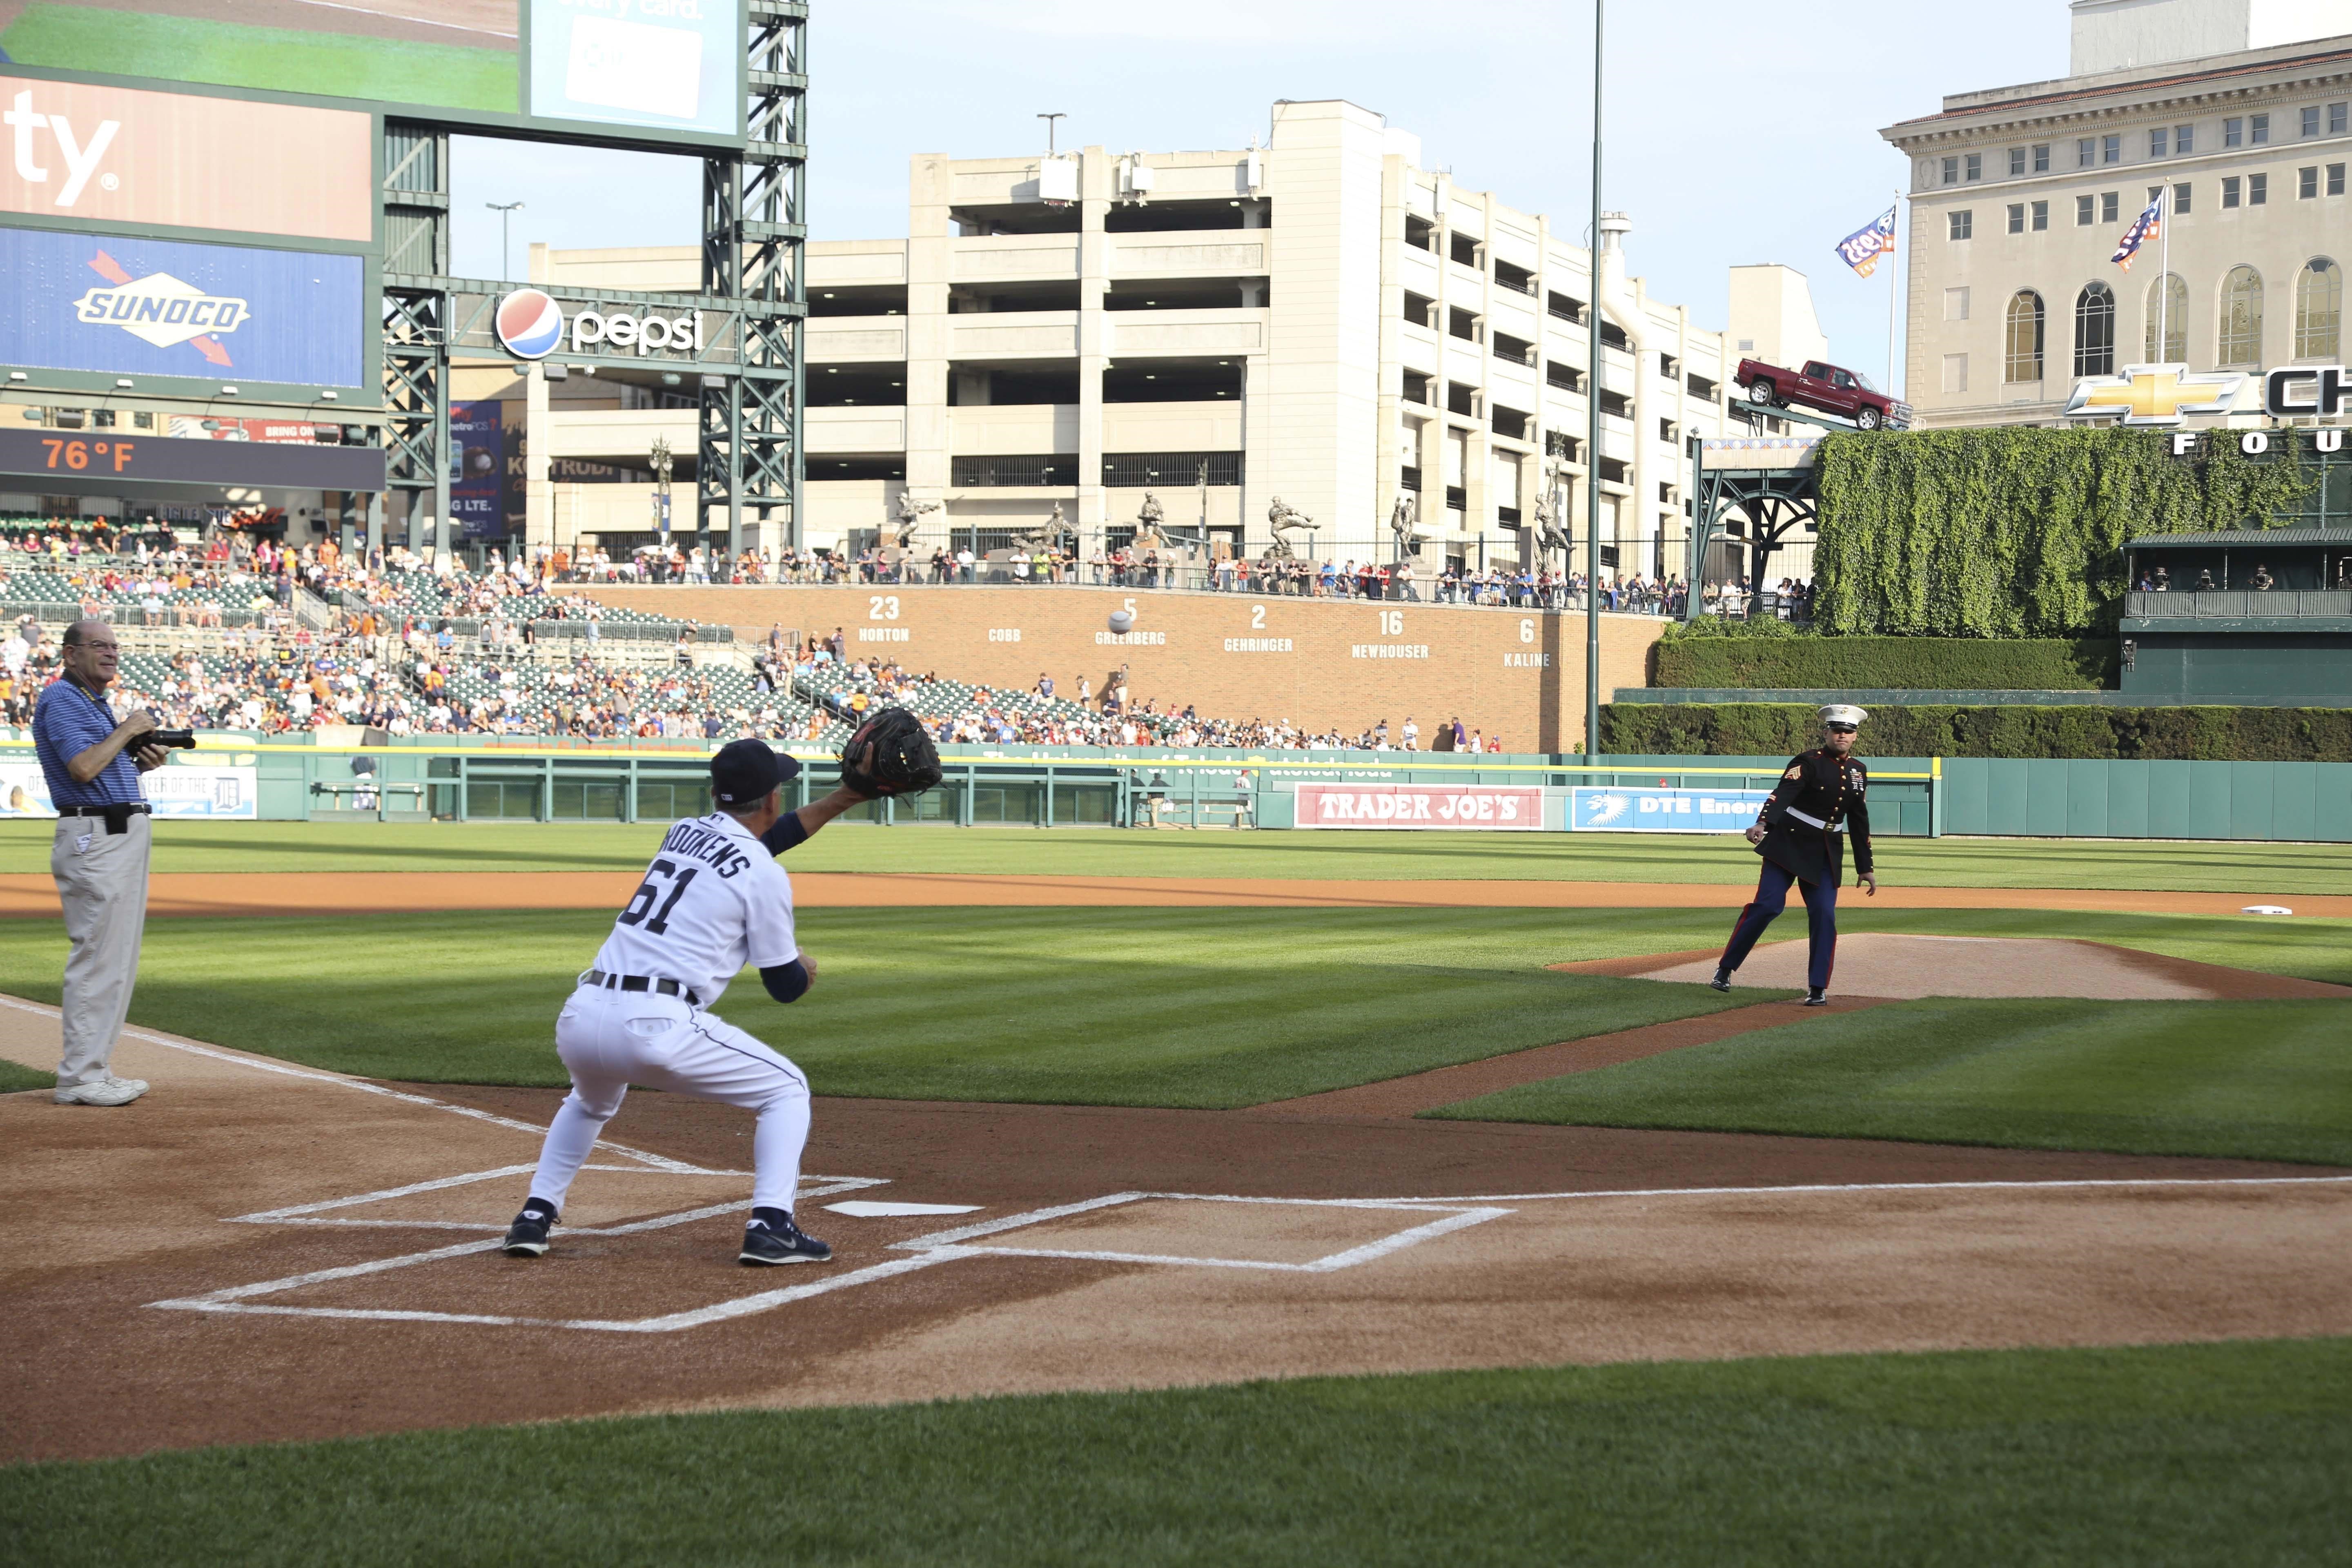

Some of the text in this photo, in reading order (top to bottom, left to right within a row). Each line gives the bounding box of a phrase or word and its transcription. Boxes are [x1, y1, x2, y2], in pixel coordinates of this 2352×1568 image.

[85, 293, 238, 327] SUNOCO
[572, 311, 703, 356] pepsi
[265, 426, 297, 437] BRING
[869, 595, 899, 620] 23
[1124, 598, 1137, 622] 5
[1251, 605, 1266, 629] 2
[859, 628, 909, 642] HORTON
[988, 628, 1020, 642] COBB
[1379, 610, 1403, 636] 16
[1519, 618, 1535, 644] 6
[1095, 631, 1166, 645] GREENBERG
[1224, 637, 1293, 653] GEHRINGER
[1352, 644, 1429, 659] NEWHOUSER
[1504, 653, 1550, 668] KALINE
[1319, 793, 1521, 820] TRADER JOE'S
[1639, 797, 1691, 814] DTE
[617, 858, 699, 935] 61
